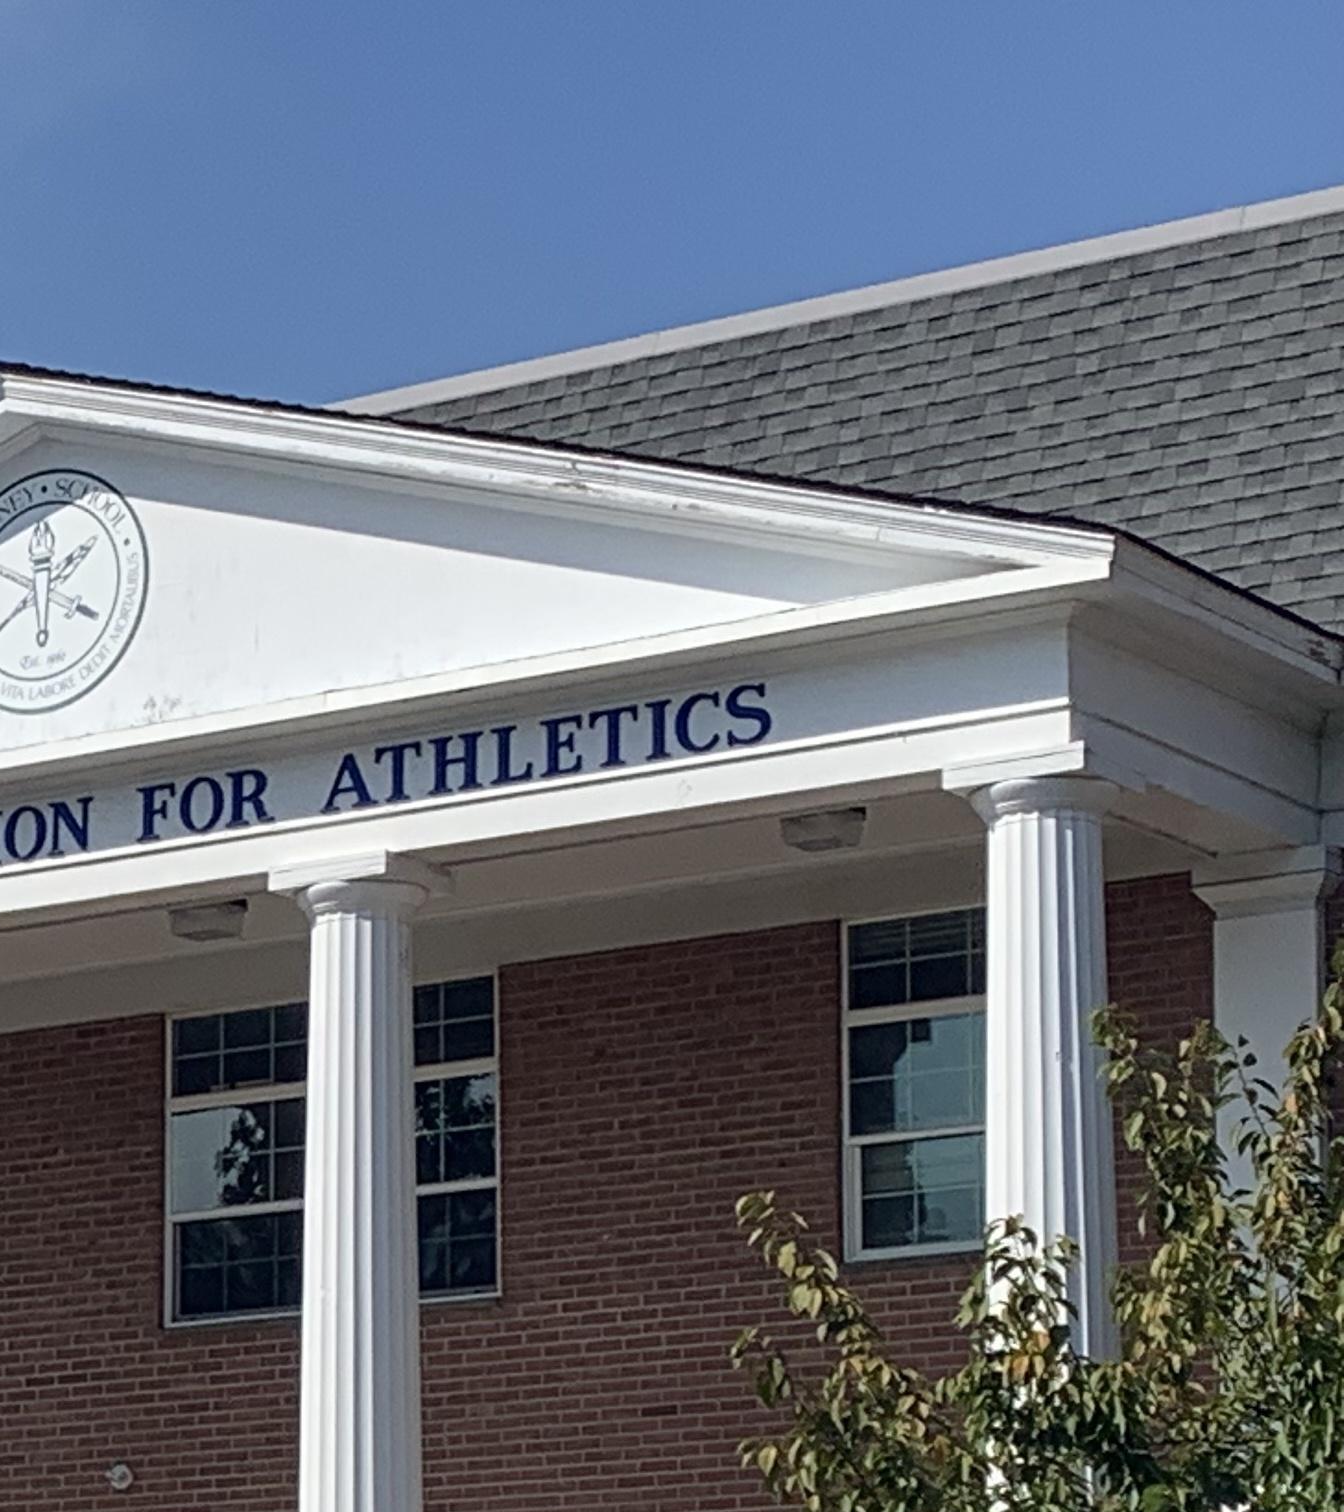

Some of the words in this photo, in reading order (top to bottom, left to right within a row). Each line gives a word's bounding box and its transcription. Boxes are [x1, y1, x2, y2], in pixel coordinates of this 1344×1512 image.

[54, 478, 126, 534] SCHOOL
[0, 682, 24, 701] VITA
[28, 674, 76, 701] LABORE
[78, 644, 111, 681] DEDIT
[135, 768, 275, 844] FOR
[318, 682, 773, 816] ATHLETICS
